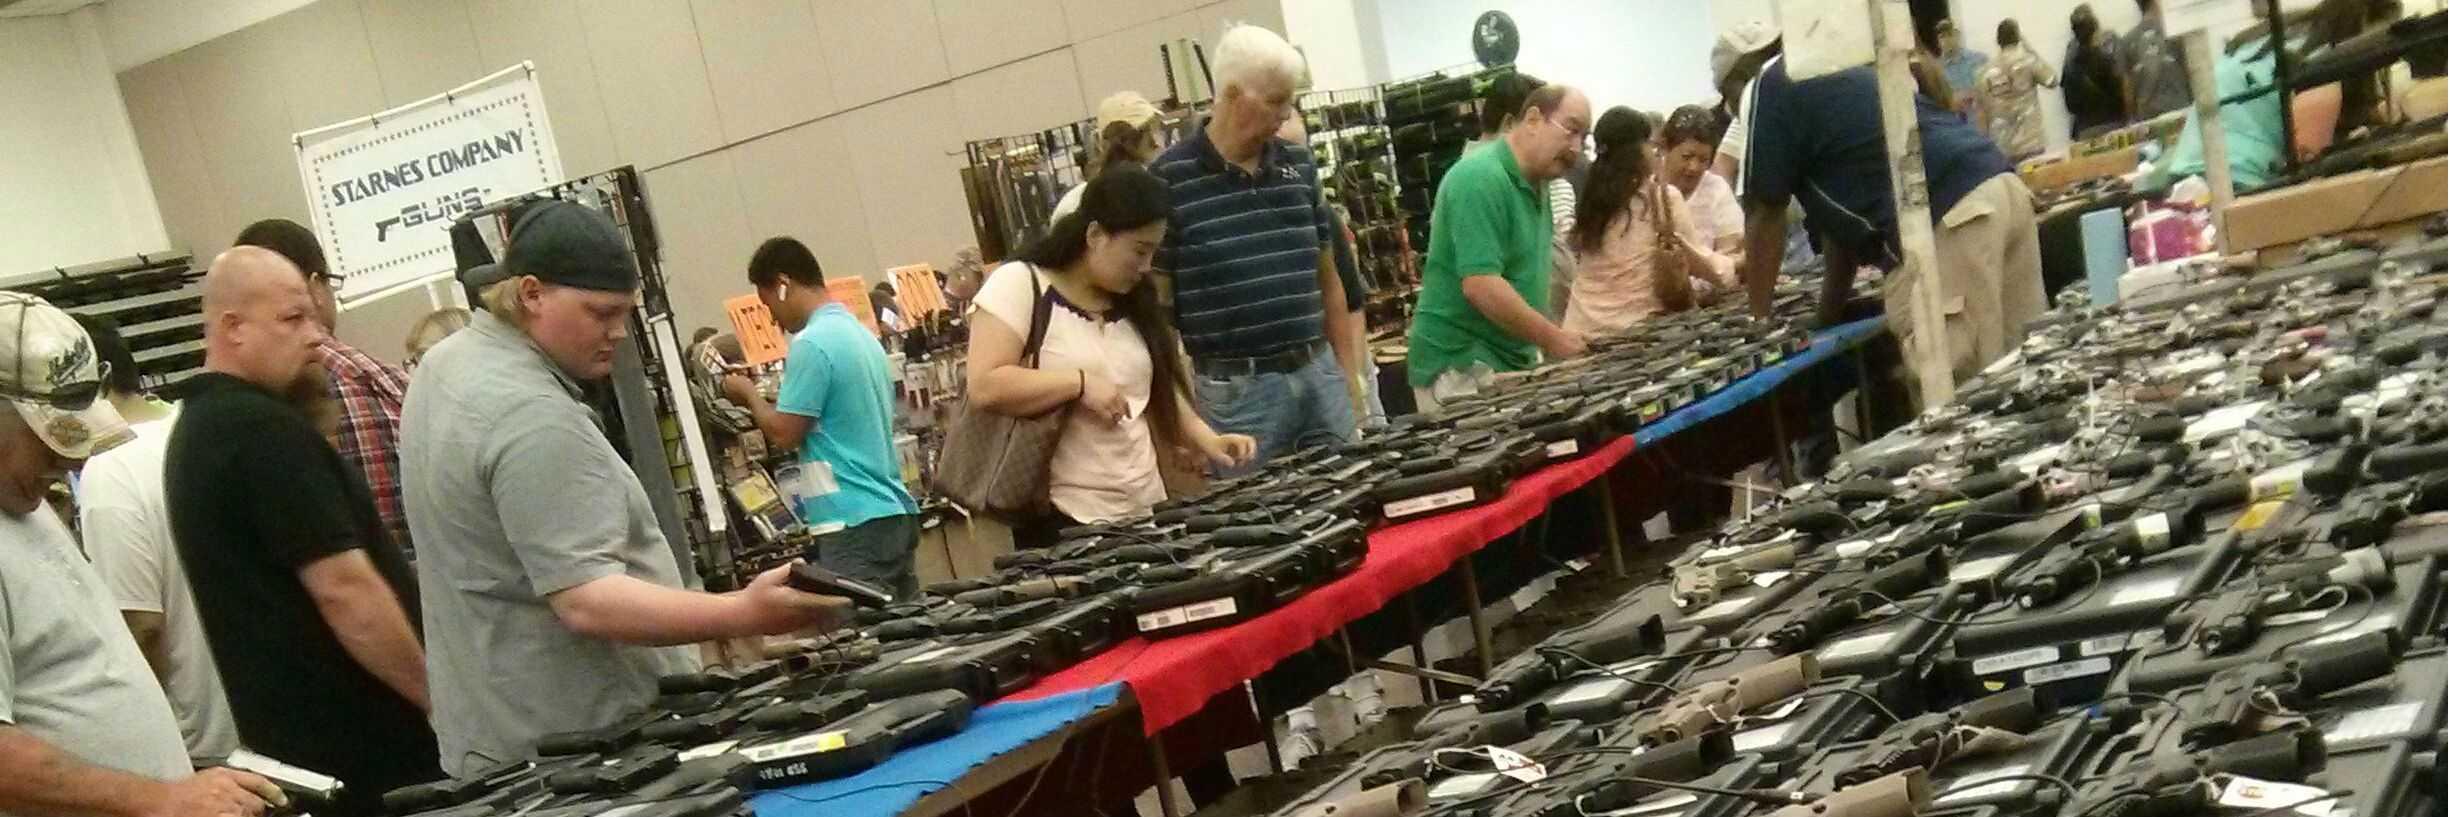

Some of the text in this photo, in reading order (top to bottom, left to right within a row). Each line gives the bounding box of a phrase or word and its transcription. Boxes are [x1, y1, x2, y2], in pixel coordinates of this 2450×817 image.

[331, 128, 524, 207] STARNES COMPANY
[401, 187, 485, 228] GUNS
